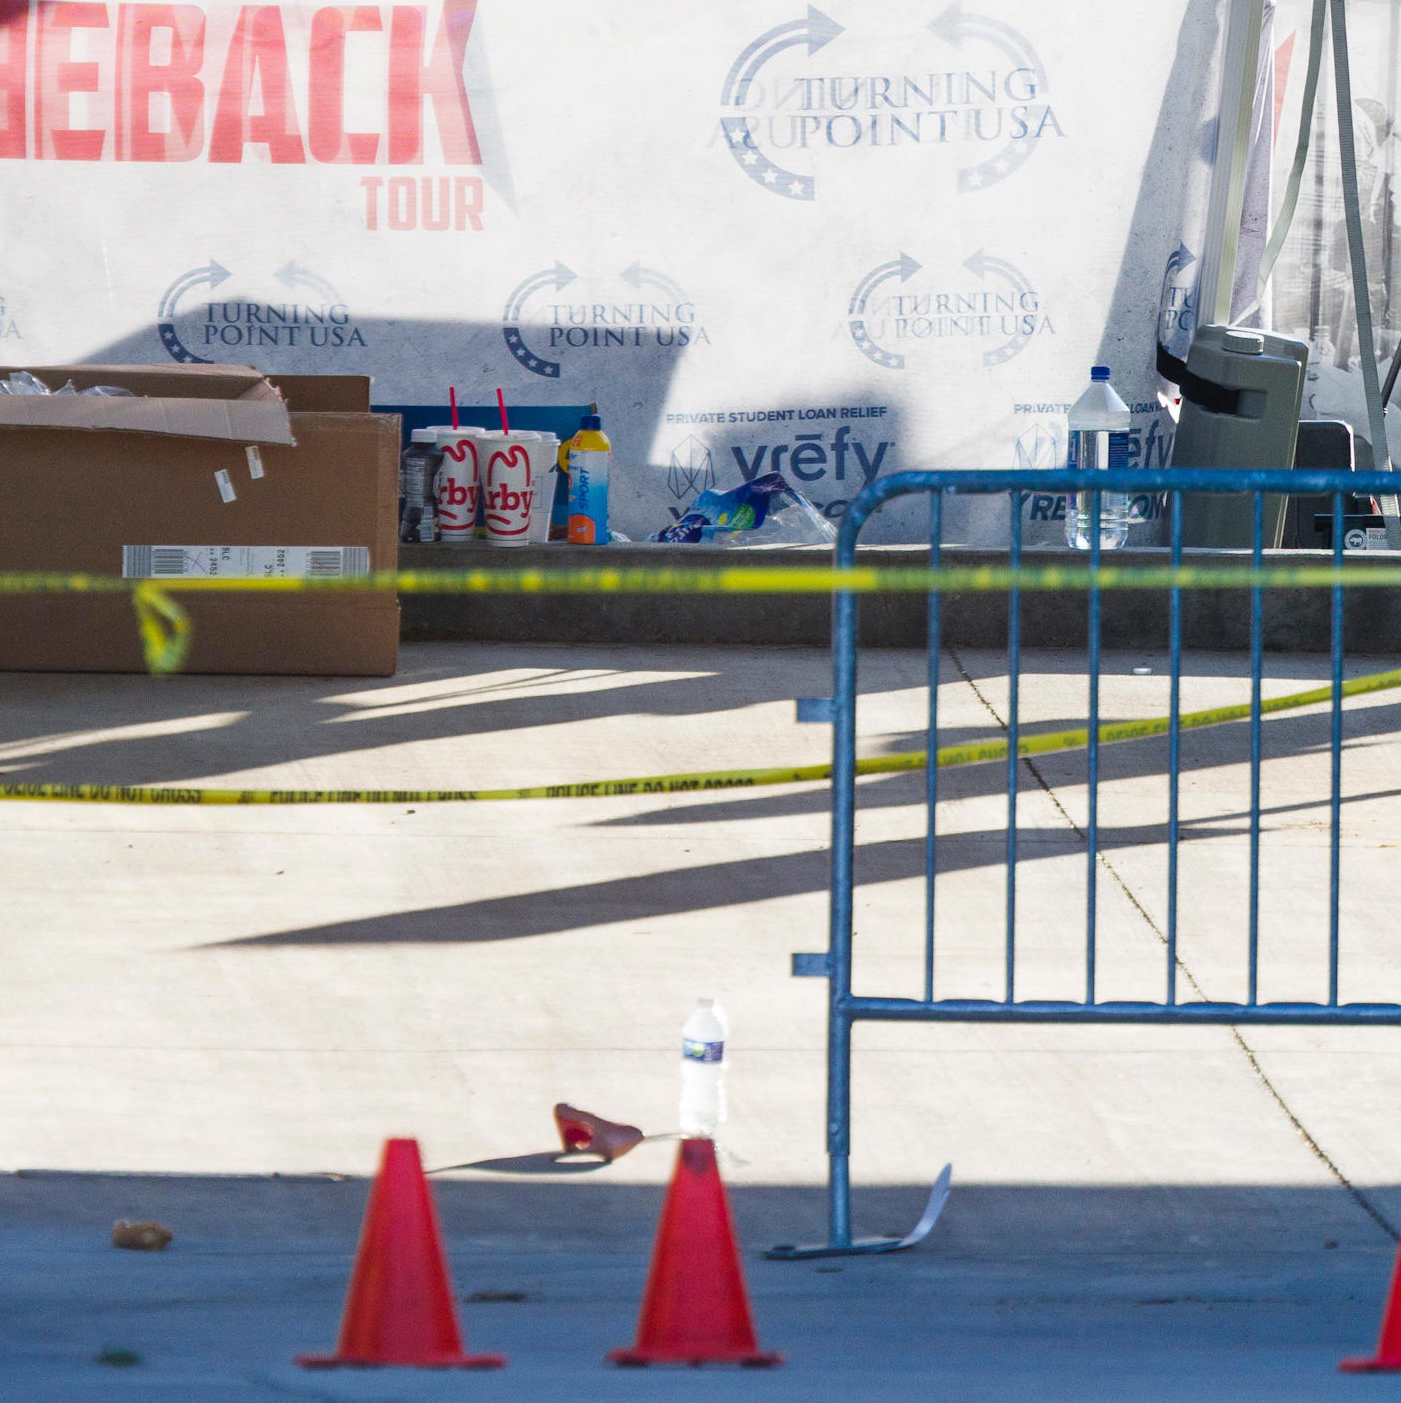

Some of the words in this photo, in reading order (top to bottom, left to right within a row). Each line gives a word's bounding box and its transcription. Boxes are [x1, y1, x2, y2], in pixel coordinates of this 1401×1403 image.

[794, 66, 1037, 112] TURNING
[797, 110, 958, 148] POINT
[972, 104, 1067, 142] USA
[359, 176, 484, 231] TOUR
[203, 301, 350, 325] TURNING
[549, 302, 695, 325] TURNING
[892, 291, 1039, 315] TURNING
[549, 325, 651, 348] POINT
[656, 324, 711, 346] USA
[1000, 312, 1056, 336] USA
[203, 325, 306, 347] POINT
[311, 326, 367, 348] USA
[666, 412, 726, 425] PRIVATE
[728, 409, 795, 423] STUDENT
[798, 407, 838, 421] LOAN
[840, 406, 887, 419] RELIEF
[1014, 403, 1071, 415] PRIVATE
[579, 466, 591, 512] SPORT
